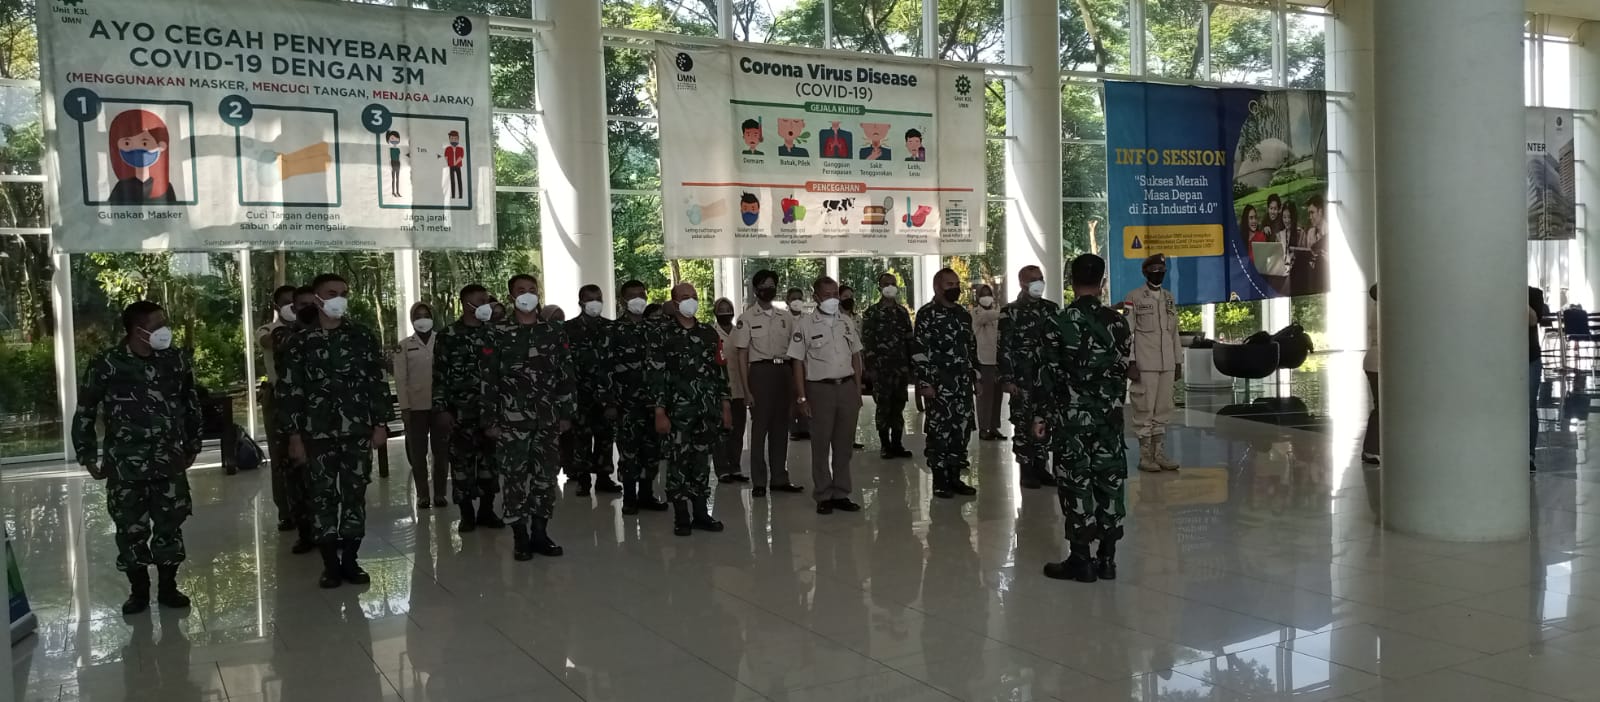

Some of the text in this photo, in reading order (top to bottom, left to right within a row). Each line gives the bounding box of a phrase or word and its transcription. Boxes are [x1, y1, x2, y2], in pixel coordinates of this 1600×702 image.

[61, 15, 82, 24] UMN
[89, 19, 447, 65] AYO CEGAH PENYEBARAN
[452, 38, 474, 47] UMN
[129, 47, 424, 86] COVID-19 DENGAN 3M
[740, 56, 918, 87] Corona Virus Disease
[677, 73, 696, 82] UMN
[66, 72, 474, 106] (MENGGUNAKAN MASKER, MENCUCI TANGAN, MENJAGA JARAK)
[795, 82, 873, 102] (COVID-19)
[77, 96, 87, 114] 1
[228, 101, 242, 119] 2
[810, 104, 860, 114] GEJALA KLINIS
[371, 109, 383, 126] 3
[1115, 148, 1226, 166] INFO SESSION
[1176, 175, 1208, 186] Meraih
[812, 183, 860, 192] PENCEGAHAN
[1144, 188, 1203, 202] Masa Depan
[1128, 203, 1140, 214] di
[1142, 204, 1159, 214] Era
[1160, 202, 1198, 214] Industri
[98, 210, 183, 220] Gunakan Masker
[246, 211, 268, 220] Cuci
[305, 212, 340, 221] dengan
[426, 214, 447, 222] jarak
[240, 222, 270, 230] sabun
[305, 224, 346, 232] mengalir
